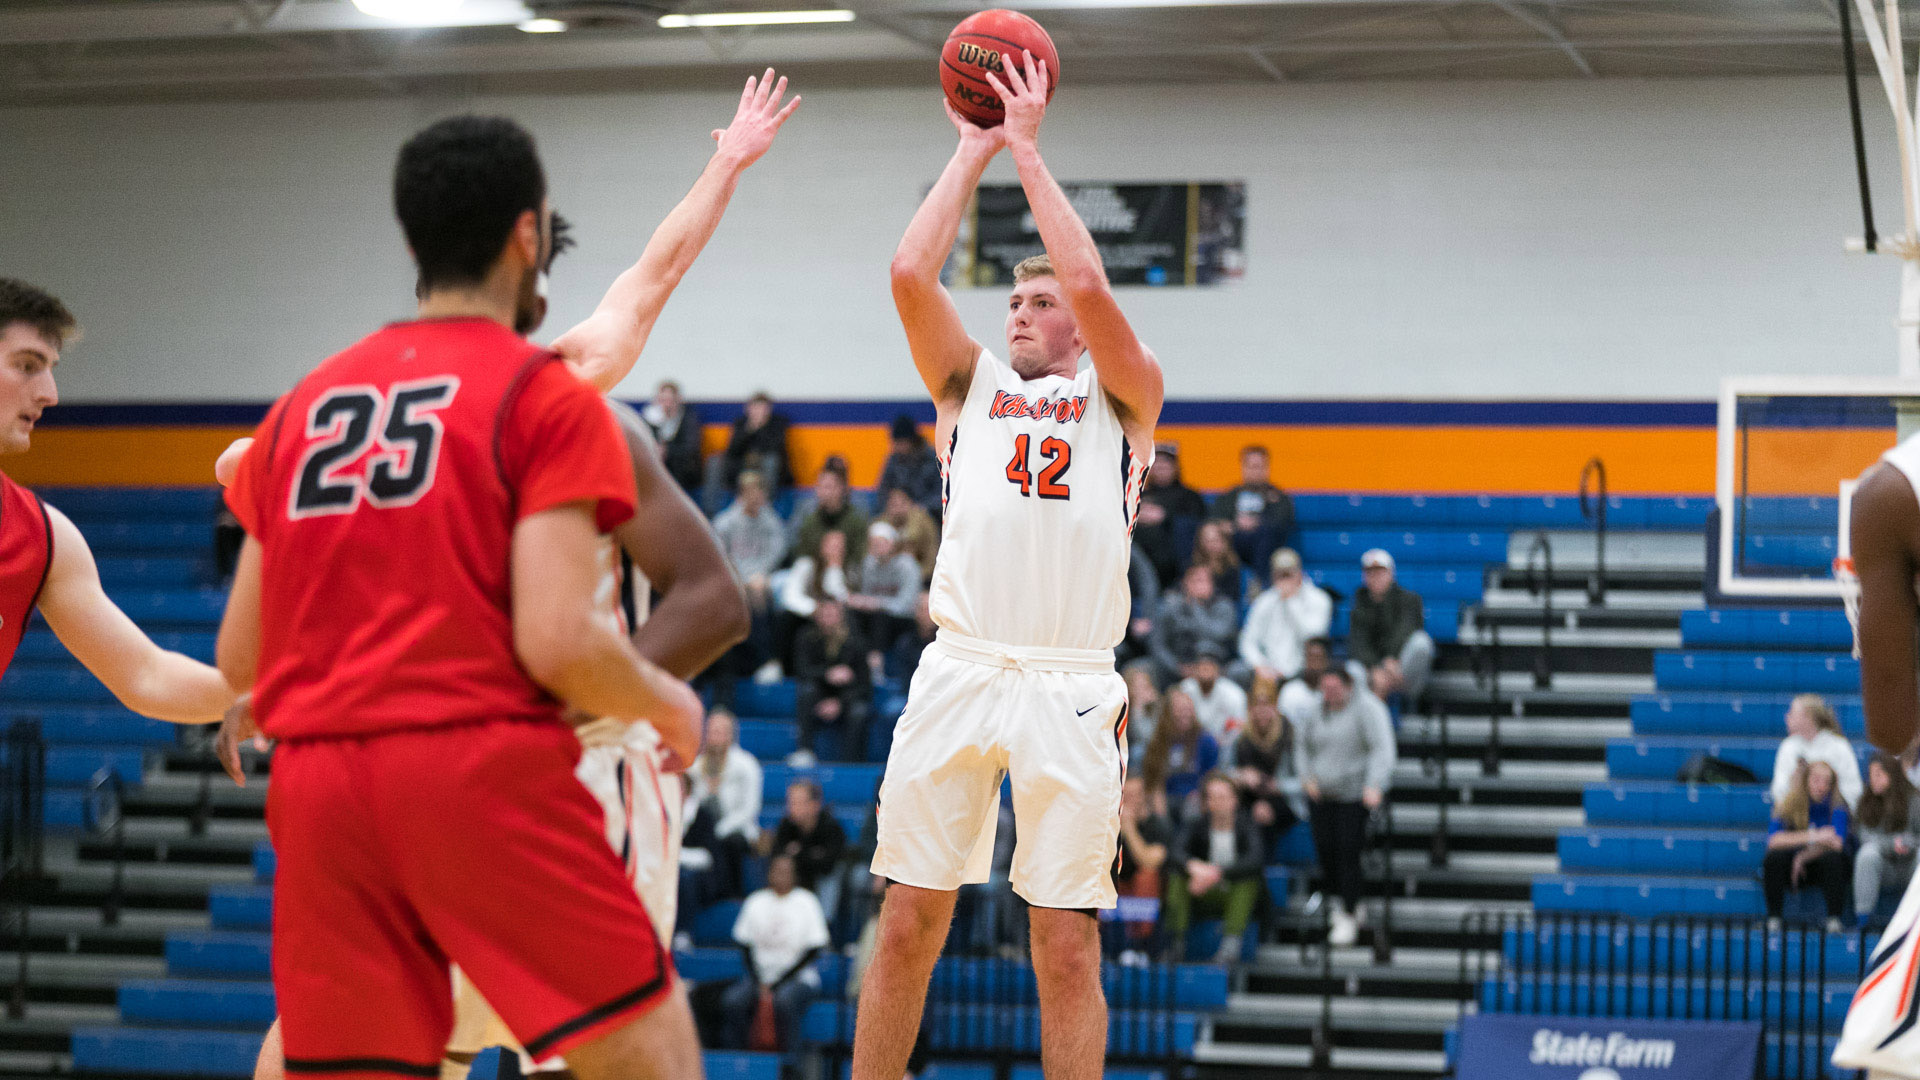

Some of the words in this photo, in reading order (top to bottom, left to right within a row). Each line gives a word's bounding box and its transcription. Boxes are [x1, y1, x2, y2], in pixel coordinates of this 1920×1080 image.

[958, 42, 1026, 79] Wils
[287, 374, 461, 521] 25
[1006, 434, 1071, 500] 42
